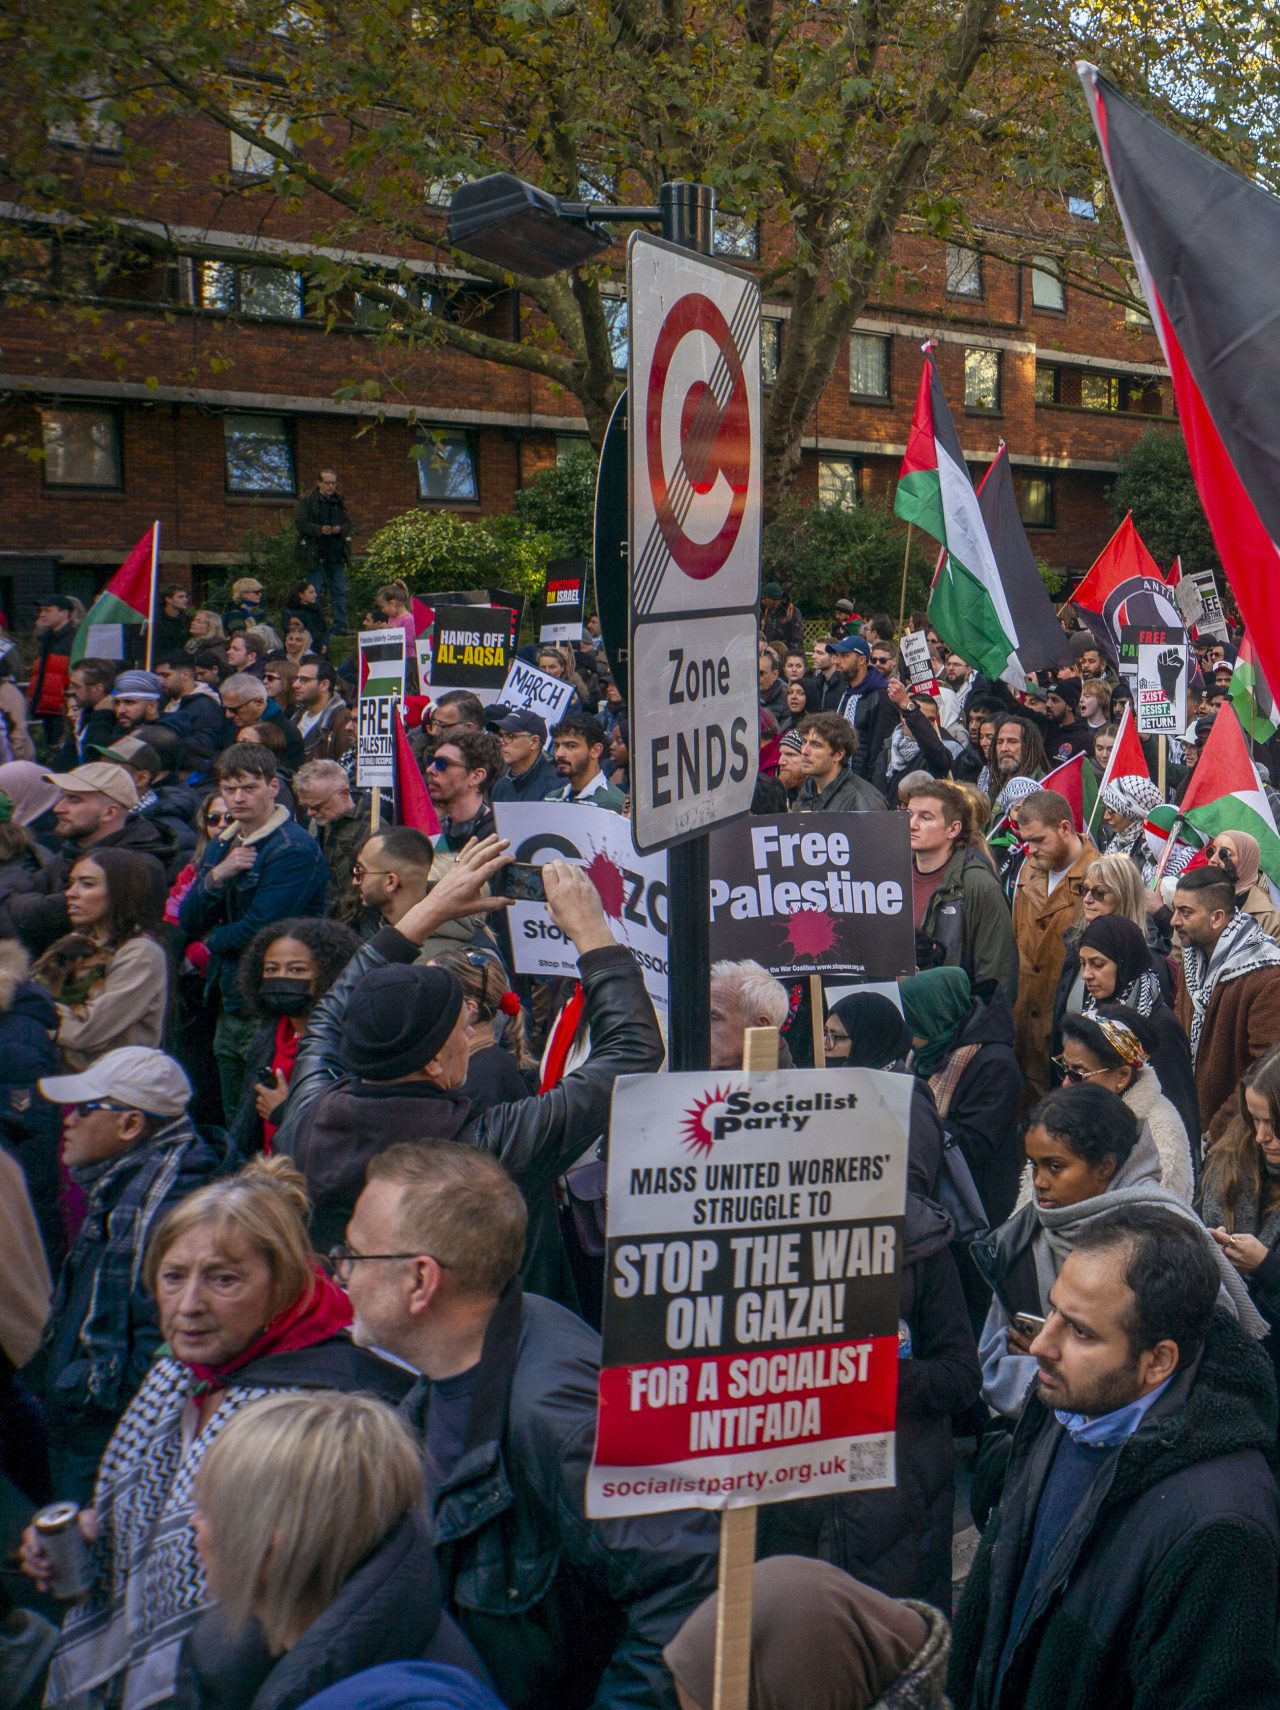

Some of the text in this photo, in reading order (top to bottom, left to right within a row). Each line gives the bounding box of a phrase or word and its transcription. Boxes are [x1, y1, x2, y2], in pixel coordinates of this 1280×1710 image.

[546, 589, 580, 603] ON ISRAEL
[1202, 596, 1220, 613] REE
[440, 630, 505, 647] HANDS OFF
[1139, 631, 1166, 644] FREE
[437, 645, 505, 667] AL-AQSA
[509, 666, 564, 710] MARCH
[669, 648, 730, 704] Zone
[1140, 691, 1167, 702] EXIST.
[1141, 705, 1170, 716] RESIST.
[1142, 717, 1176, 729] RETURN.
[359, 736, 393, 754] PALESTIN
[651, 716, 749, 808] ENDS
[751, 826, 850, 869] Free
[709, 871, 903, 922] Palestine
[538, 959, 576, 969] Stop the
[792, 964, 816, 972] Coalition
[725, 1091, 858, 1115] Socialist
[629, 1155, 891, 1195] MASS UNITED WORKERS'
[693, 1191, 831, 1225] STRUGGLE TO
[613, 1225, 896, 1299] STOP THE WAR
[666, 1284, 846, 1350] ON GAZA!
[630, 1344, 873, 1412] FOR A SOCIALIST
[689, 1397, 821, 1452] INTIFADA
[602, 1455, 846, 1498] socialistparty.org.uk
